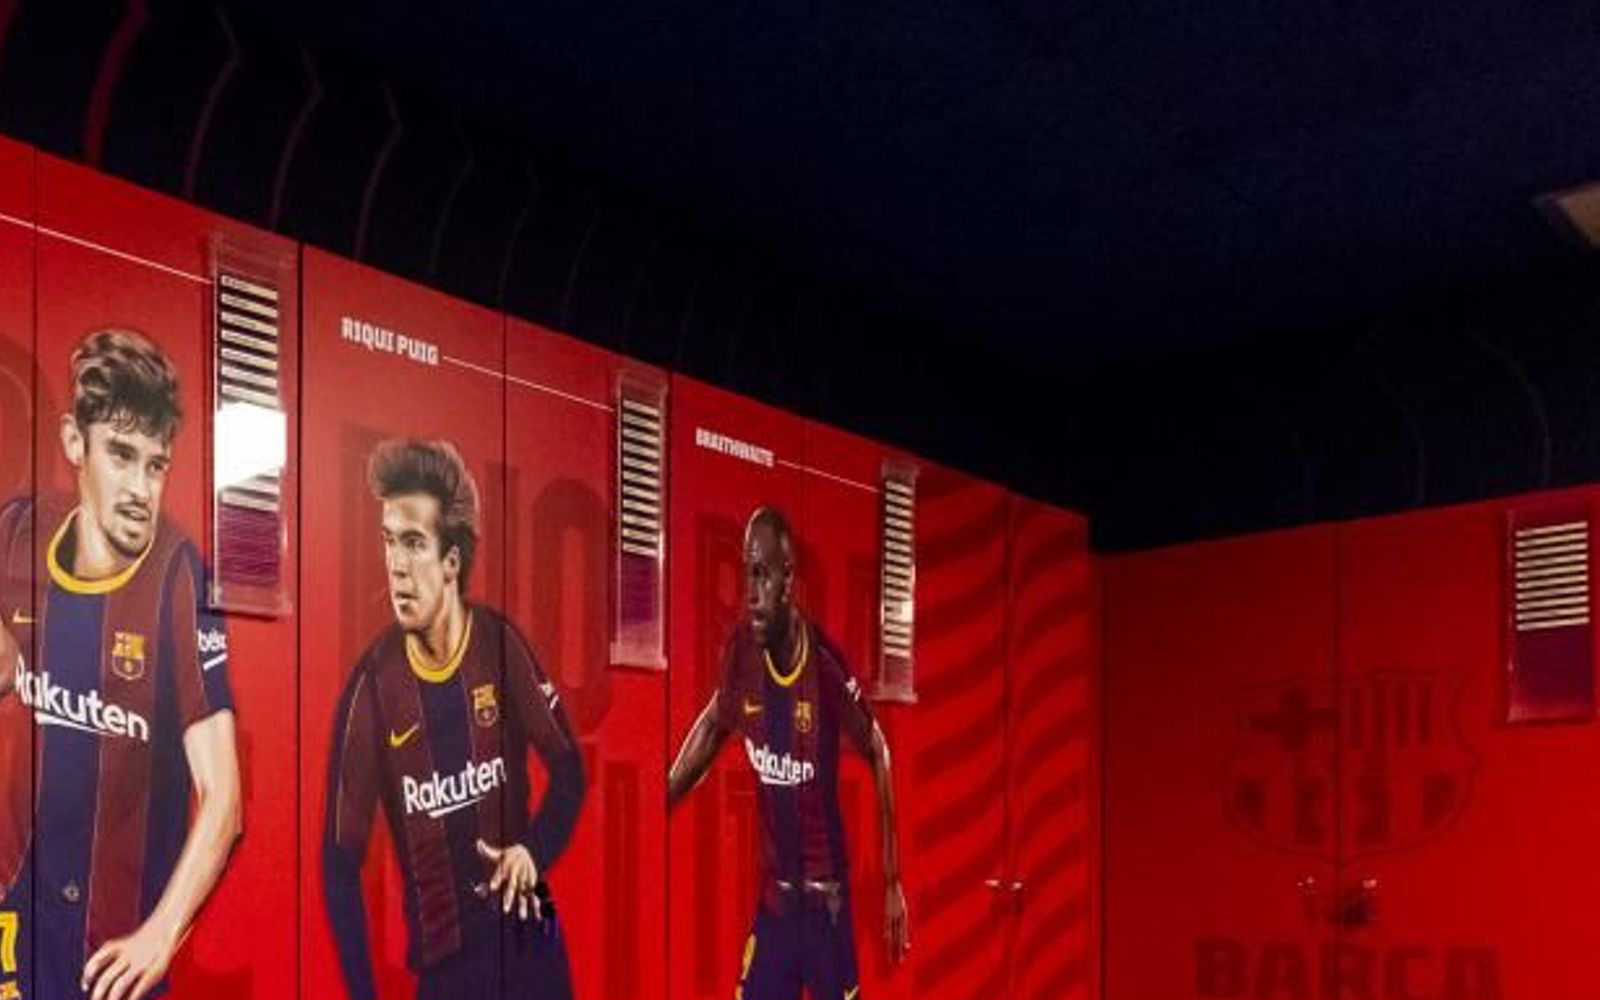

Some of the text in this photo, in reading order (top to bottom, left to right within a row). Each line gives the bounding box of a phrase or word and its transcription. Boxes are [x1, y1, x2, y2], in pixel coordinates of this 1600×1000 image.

[341, 316, 439, 366] RIQUI PUIG
[402, 757, 507, 815] Rakuten
